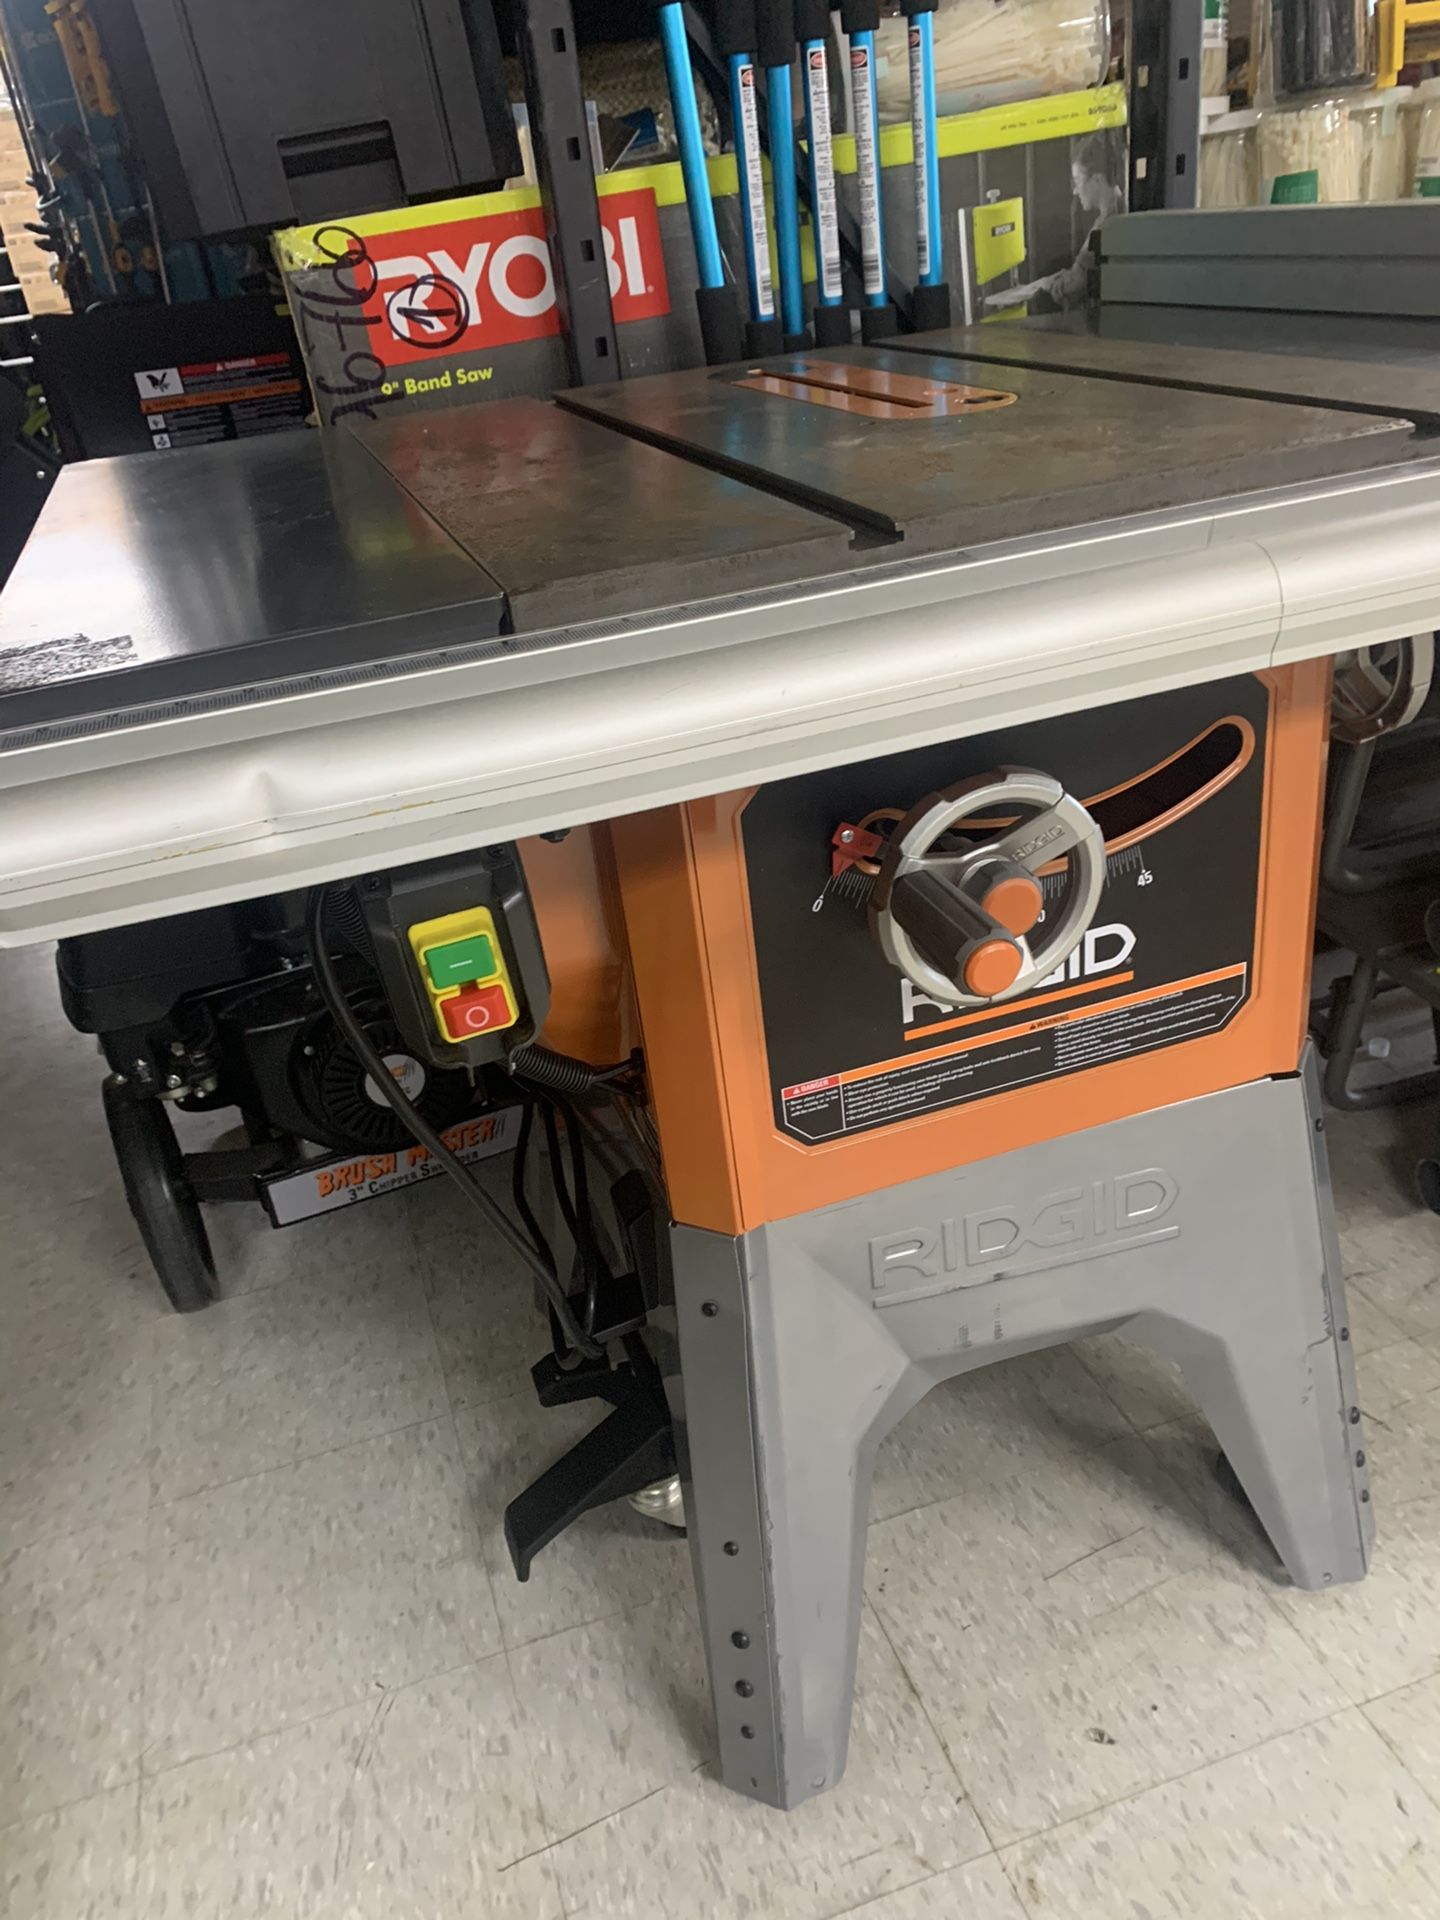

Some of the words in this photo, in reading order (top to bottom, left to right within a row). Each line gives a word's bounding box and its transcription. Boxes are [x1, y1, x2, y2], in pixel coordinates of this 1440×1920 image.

[405, 371, 452, 395] Band
[457, 367, 494, 385] Saw
[812, 898, 823, 913] 0
[1137, 870, 1153, 887] 45
[900, 922, 1137, 1025] RID
[314, 1152, 398, 1198] BRUSH
[407, 1117, 497, 1168] MSTER
[868, 1166, 1181, 1290] RIDGID
